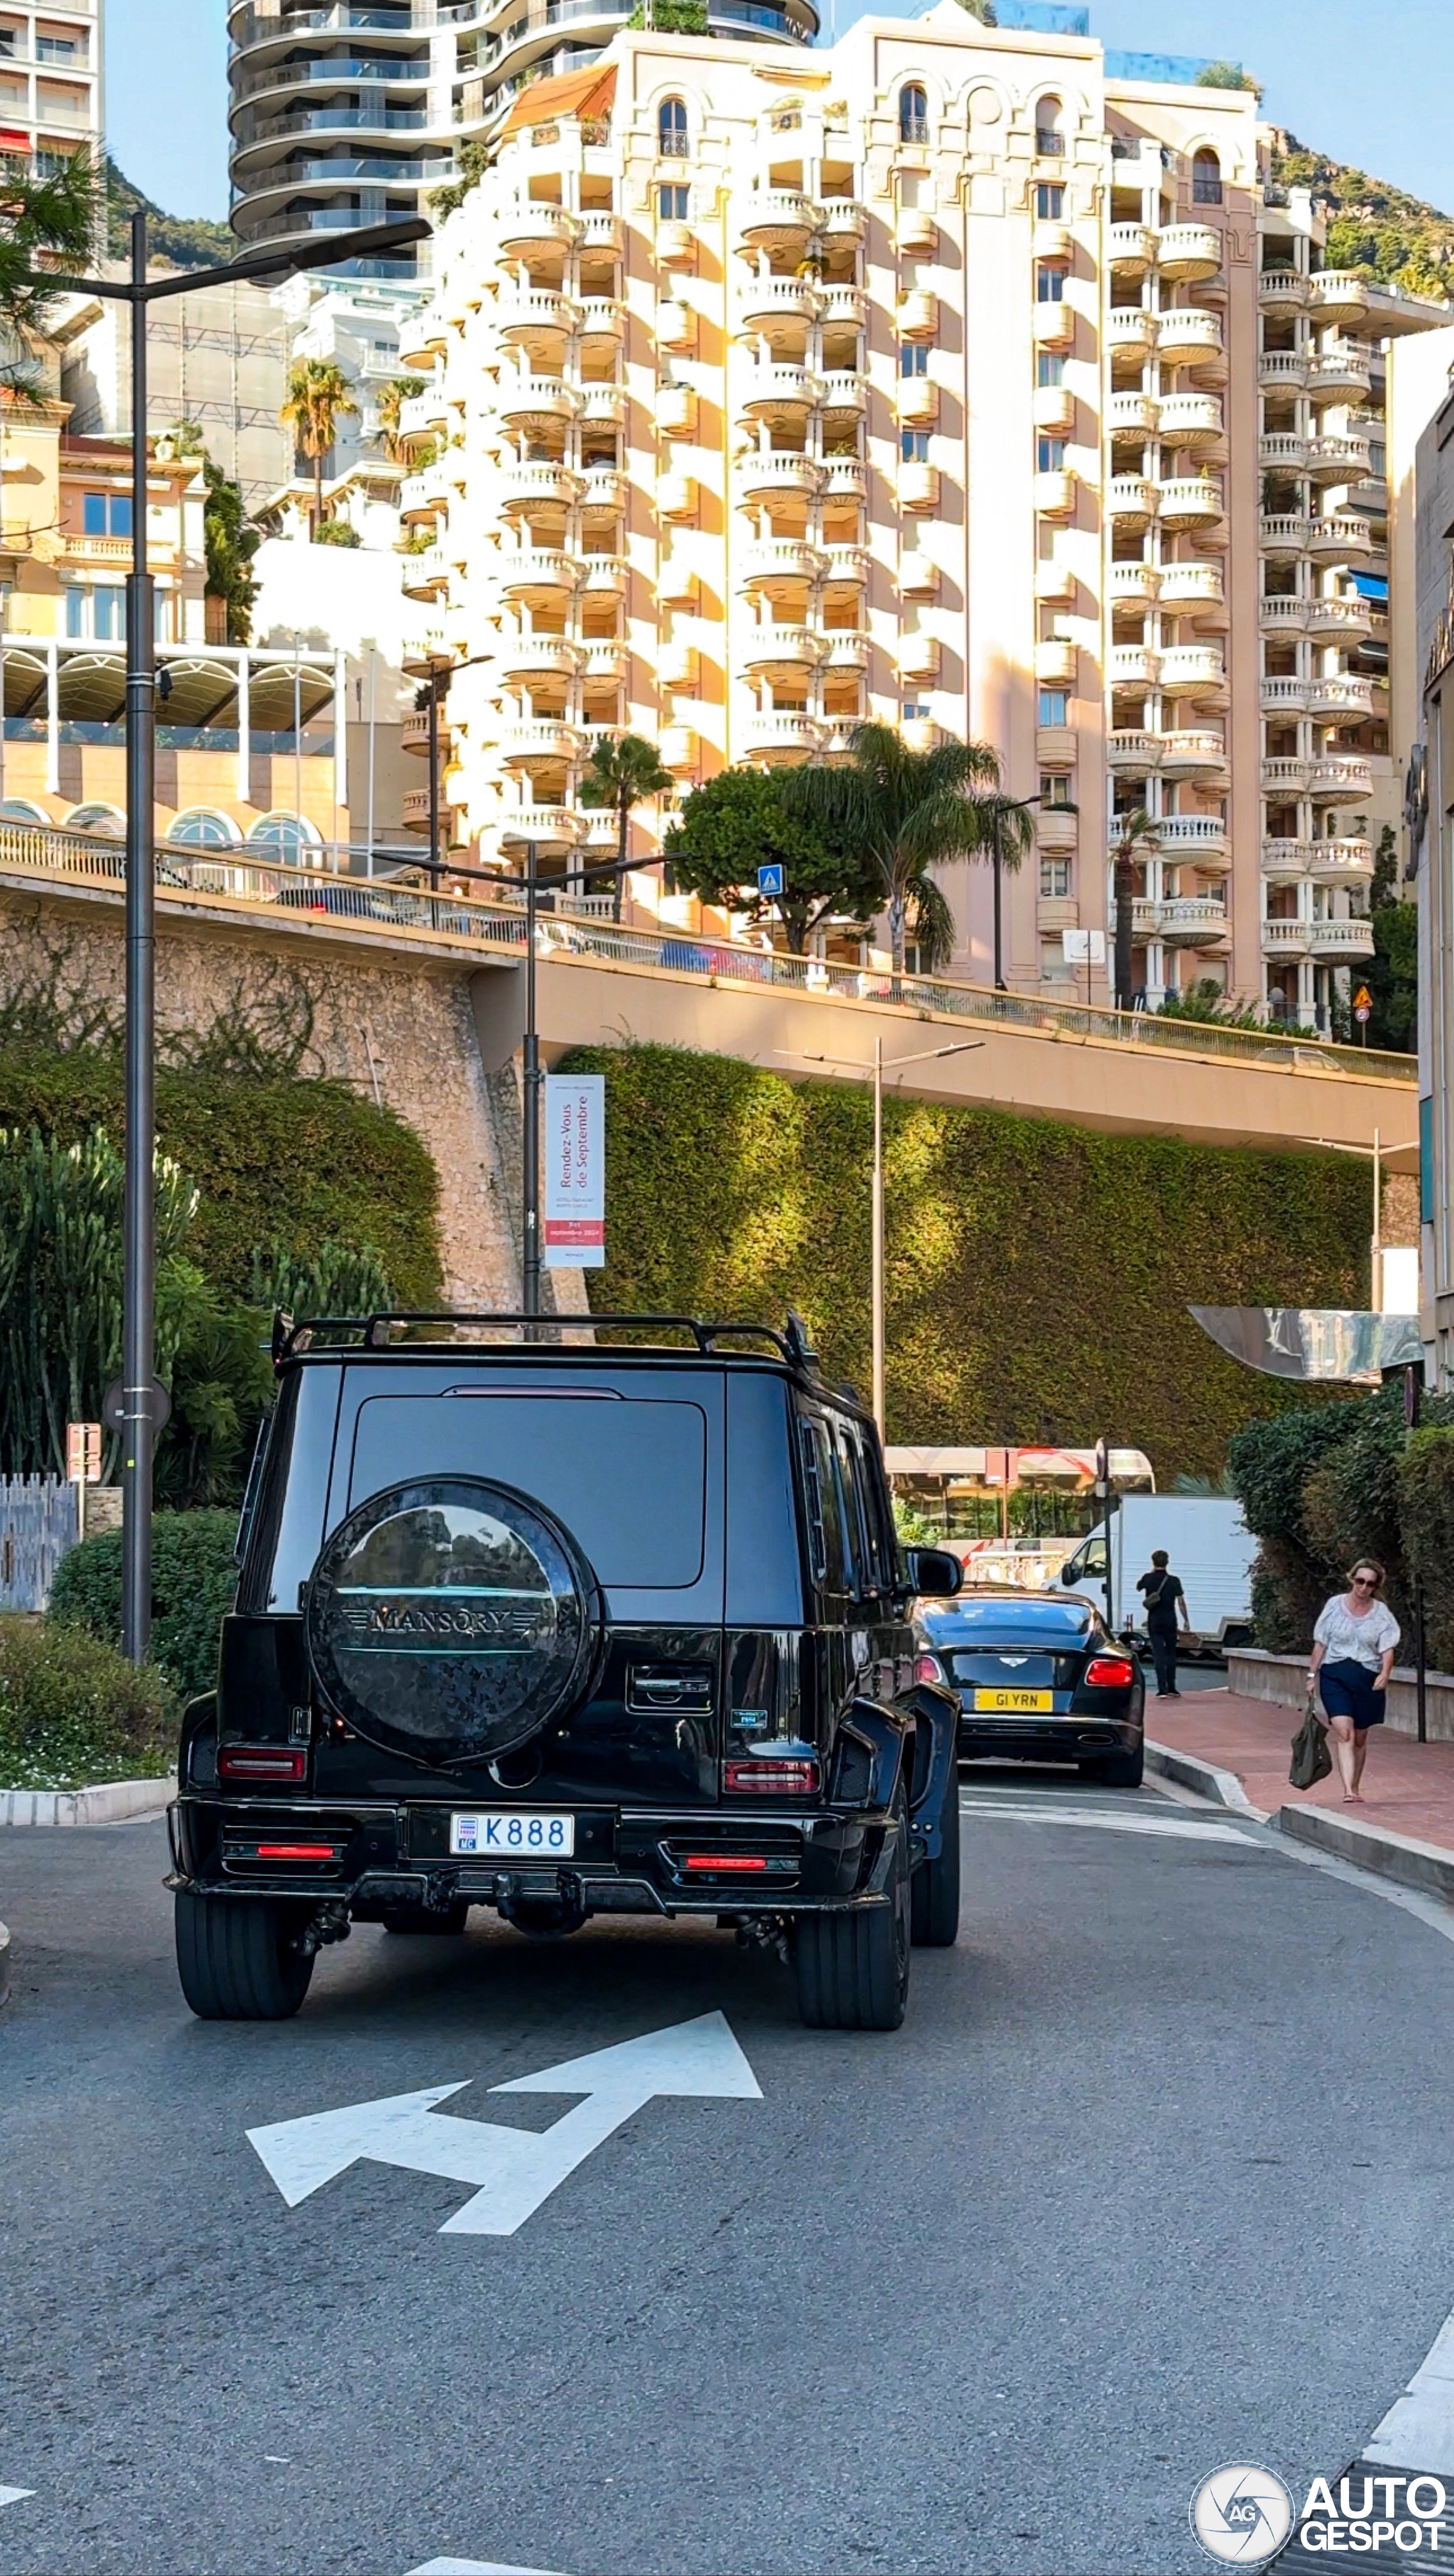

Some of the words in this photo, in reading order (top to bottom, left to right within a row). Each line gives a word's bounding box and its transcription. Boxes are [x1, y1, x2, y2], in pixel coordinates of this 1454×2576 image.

[576, 1096, 590, 1167] Septembre
[561, 1104, 571, 1188] Rendez-Vous
[576, 1172, 587, 1188] de
[370, 1608, 511, 1634] MANSORY
[1012, 1694, 1038, 1706] YRN
[486, 1818, 564, 1847] K888
